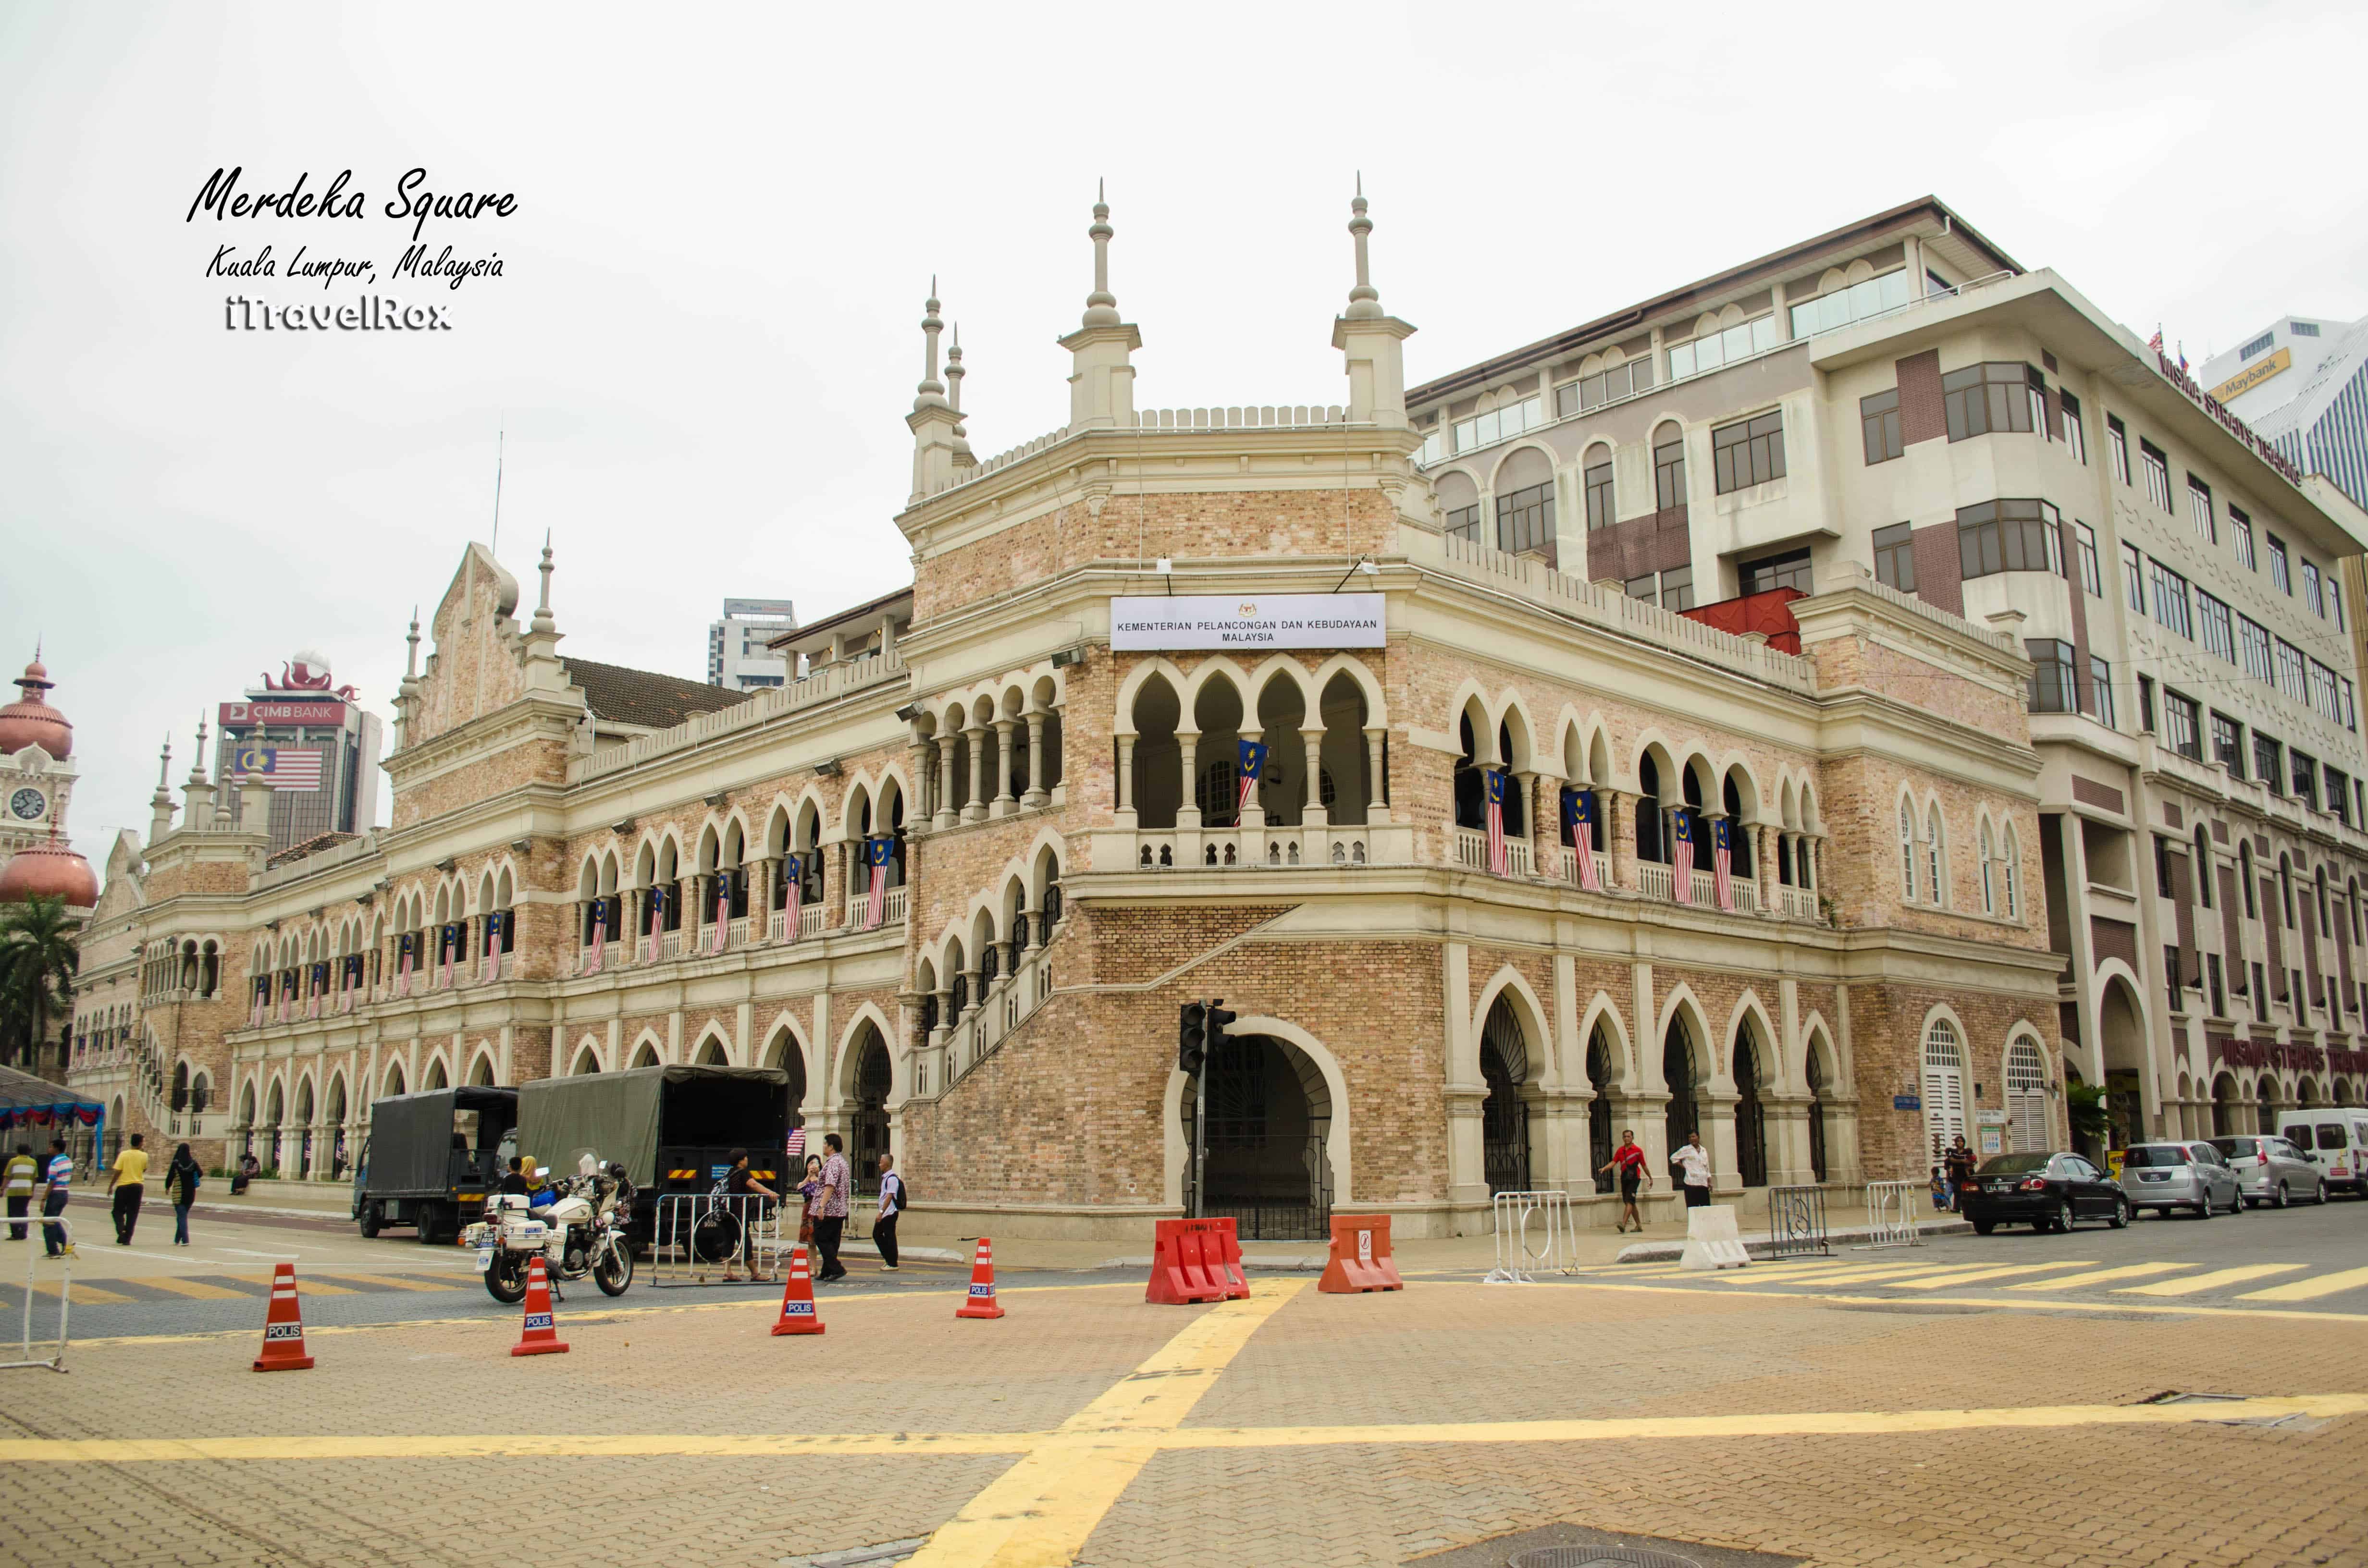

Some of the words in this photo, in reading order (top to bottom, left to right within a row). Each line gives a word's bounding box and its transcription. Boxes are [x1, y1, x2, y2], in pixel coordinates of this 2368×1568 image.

[2225, 359, 2277, 396] Maybank
[2158, 353, 2202, 404] WISMA
[2204, 392, 2254, 448] STRAITS
[1117, 622, 1192, 631] KEMENTERIAN
[1197, 621, 1276, 630] PELANCONGAN
[1281, 620, 1303, 629] DAN
[1307, 620, 1377, 629] KEBUDAYAAN
[1222, 633, 1274, 642] MALAYSIA
[254, 706, 291, 717] CIMB
[294, 706, 332, 718] BANK
[2220, 1038, 2268, 1068] WISMA
[2269, 1042, 2325, 1073] STRAITS
[971, 1286, 987, 1295] POLIS
[788, 1304, 812, 1312] POLIS
[527, 1316, 551, 1326] POLIS
[269, 1326, 300, 1337] POLIS
